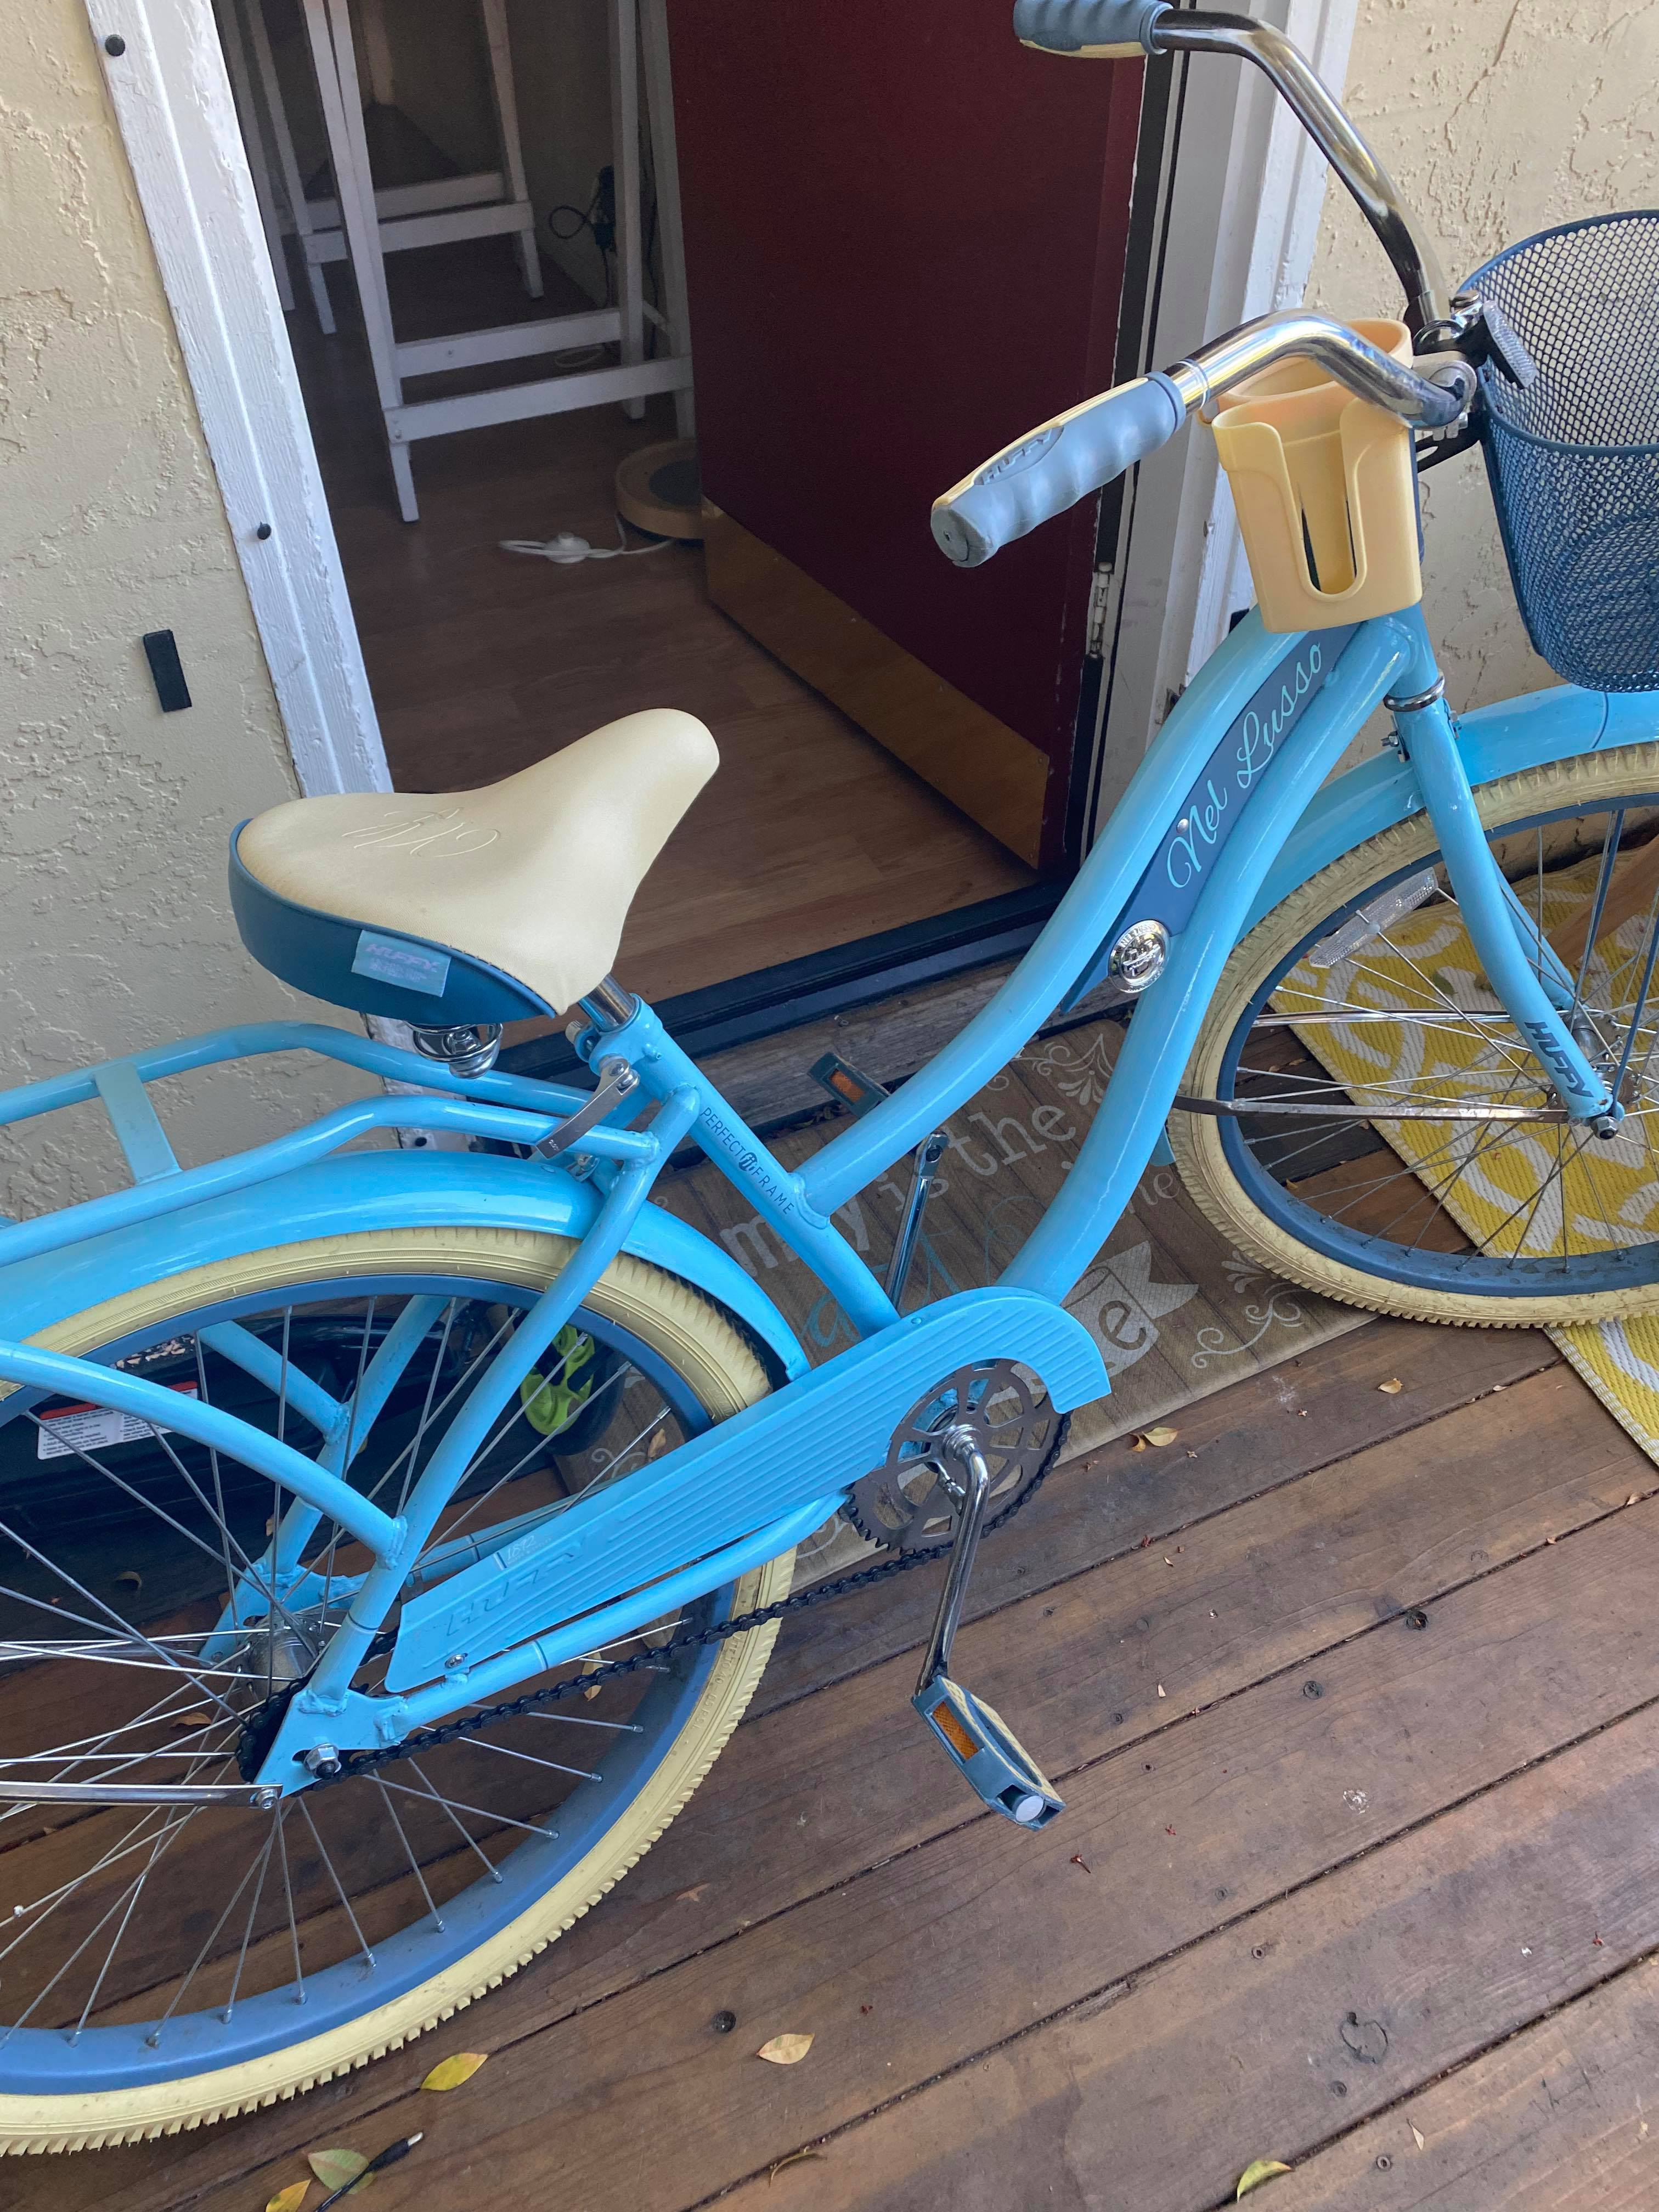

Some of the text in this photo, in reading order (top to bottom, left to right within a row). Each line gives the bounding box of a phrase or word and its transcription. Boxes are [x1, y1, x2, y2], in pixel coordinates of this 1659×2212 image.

[1167, 641, 1322, 888] Nel Lusso
[1523, 1022, 1595, 1098] HUFFY
[700, 1107, 746, 1156] PERFECT
[751, 1166, 795, 1215] FRAME
[939, 1104, 1076, 1176] the
